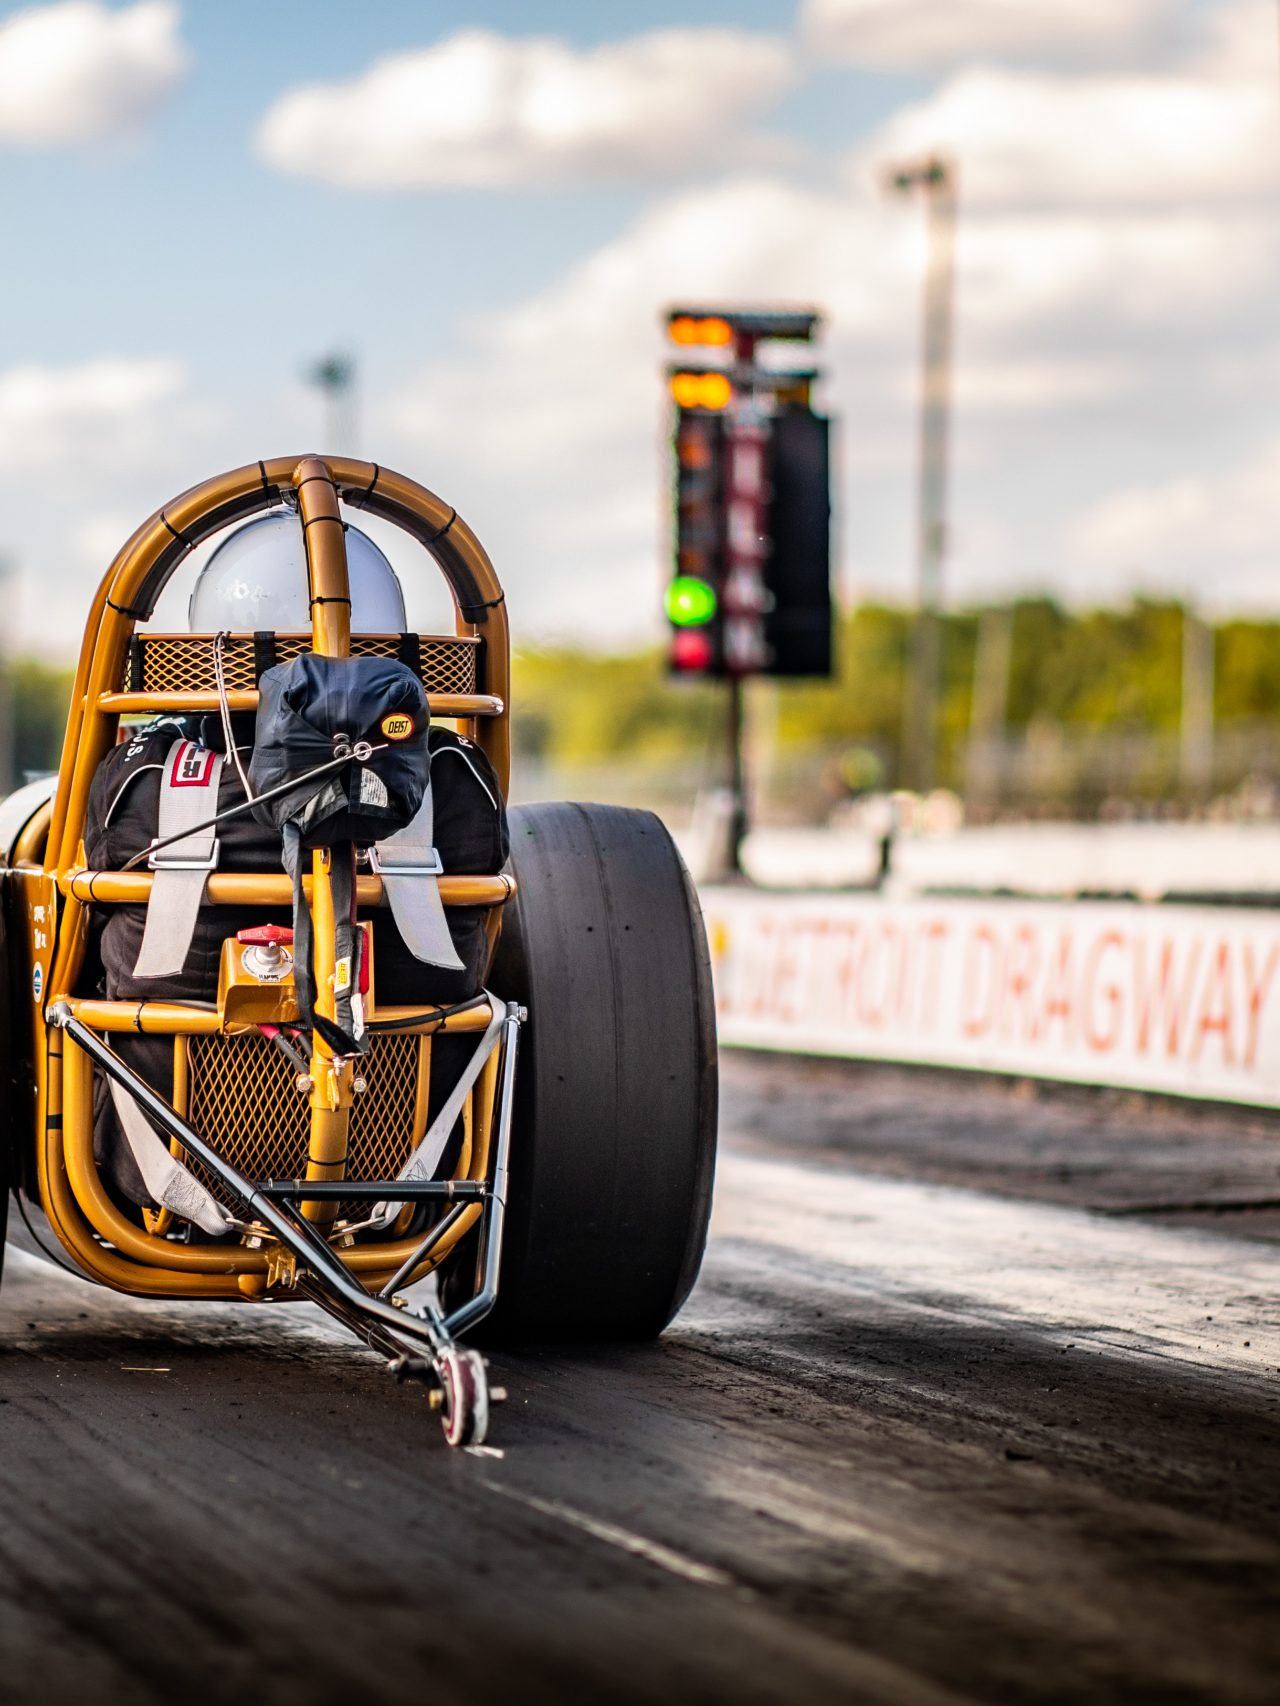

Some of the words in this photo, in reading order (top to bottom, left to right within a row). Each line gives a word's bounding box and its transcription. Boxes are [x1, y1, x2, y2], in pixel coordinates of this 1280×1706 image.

[387, 720, 409, 734] DEIST
[746, 914, 952, 1036] DETROIT
[963, 918, 1280, 1071] DRAGWAY
